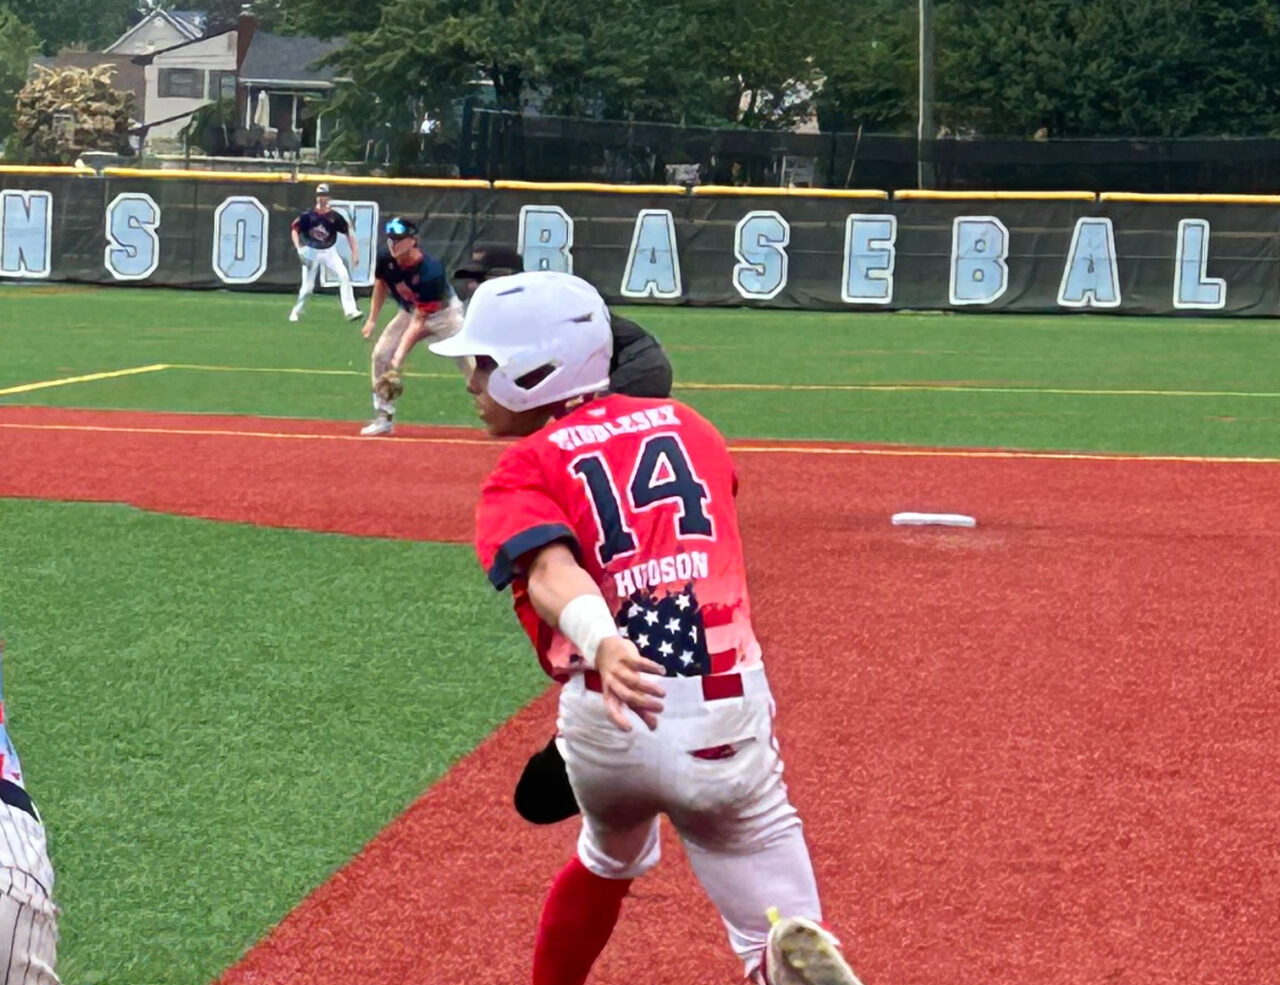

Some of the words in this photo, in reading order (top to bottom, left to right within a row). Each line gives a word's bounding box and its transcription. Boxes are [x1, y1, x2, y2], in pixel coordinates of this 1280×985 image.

[548, 405, 681, 451] MIDDLESEX
[567, 431, 717, 568] 14
[614, 551, 709, 598] HUDSON
